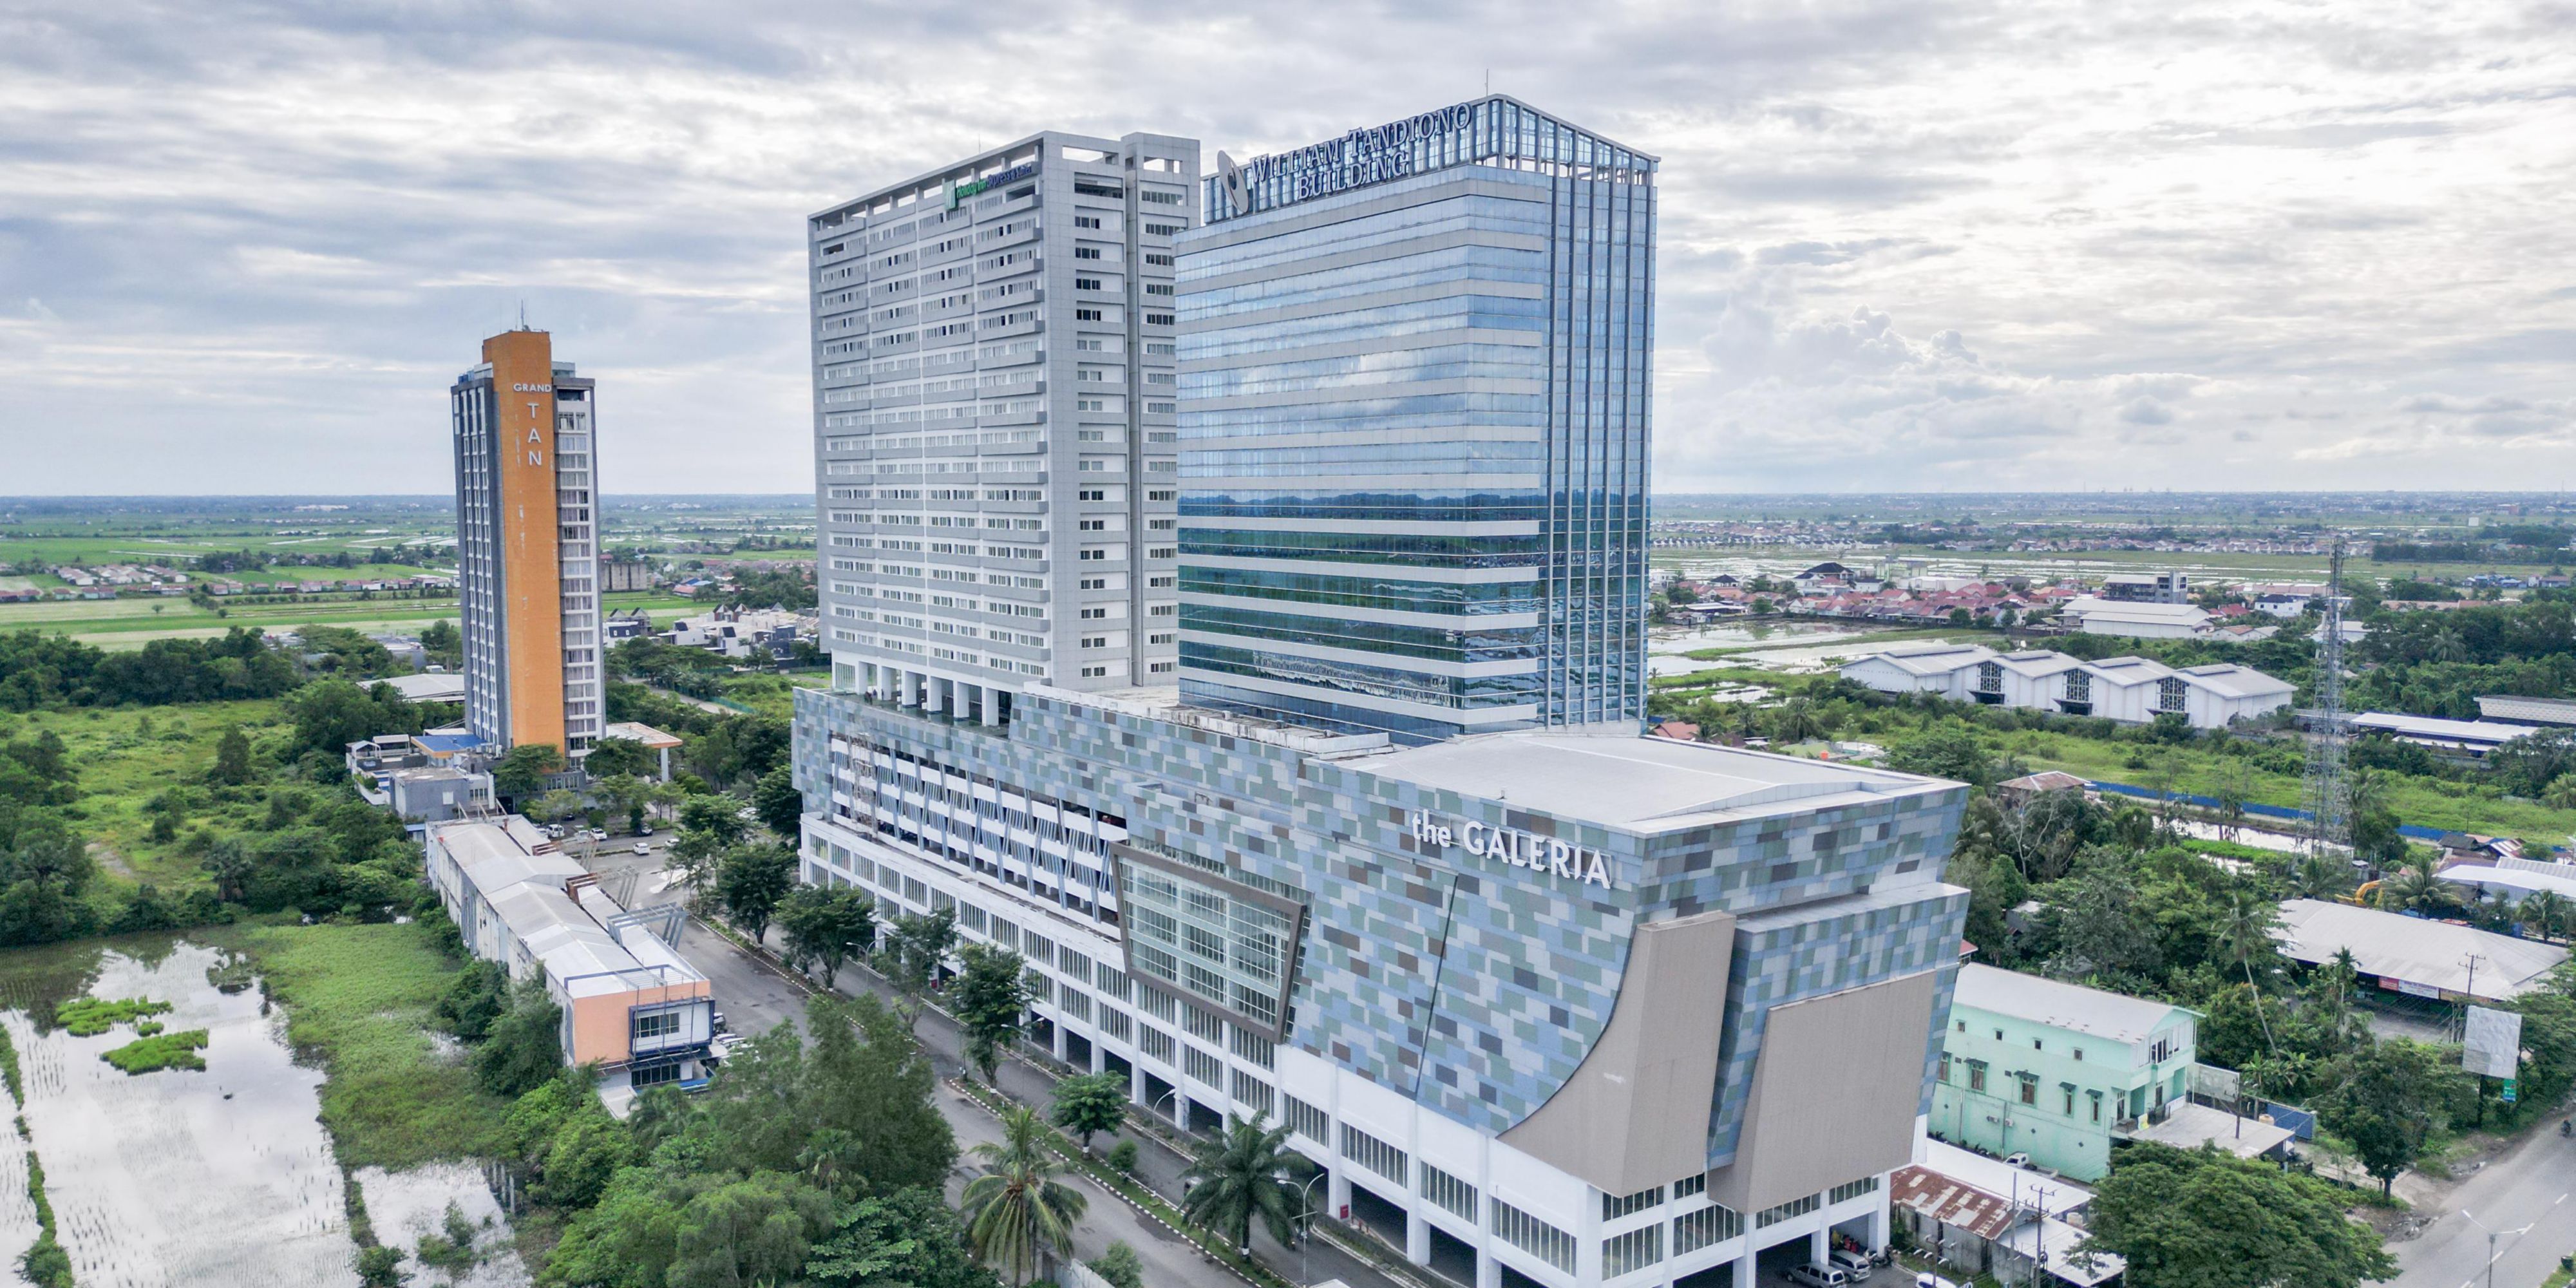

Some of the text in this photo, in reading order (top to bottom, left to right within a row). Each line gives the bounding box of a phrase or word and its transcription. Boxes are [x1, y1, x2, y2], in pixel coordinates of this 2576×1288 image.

[1249, 102, 1472, 183] WILLIAM TANDIONO
[1298, 151, 1409, 200] BUILDING
[513, 383, 552, 392] GRAND
[527, 402, 542, 466] TAN
[1412, 809, 1612, 889] the GALERIA
